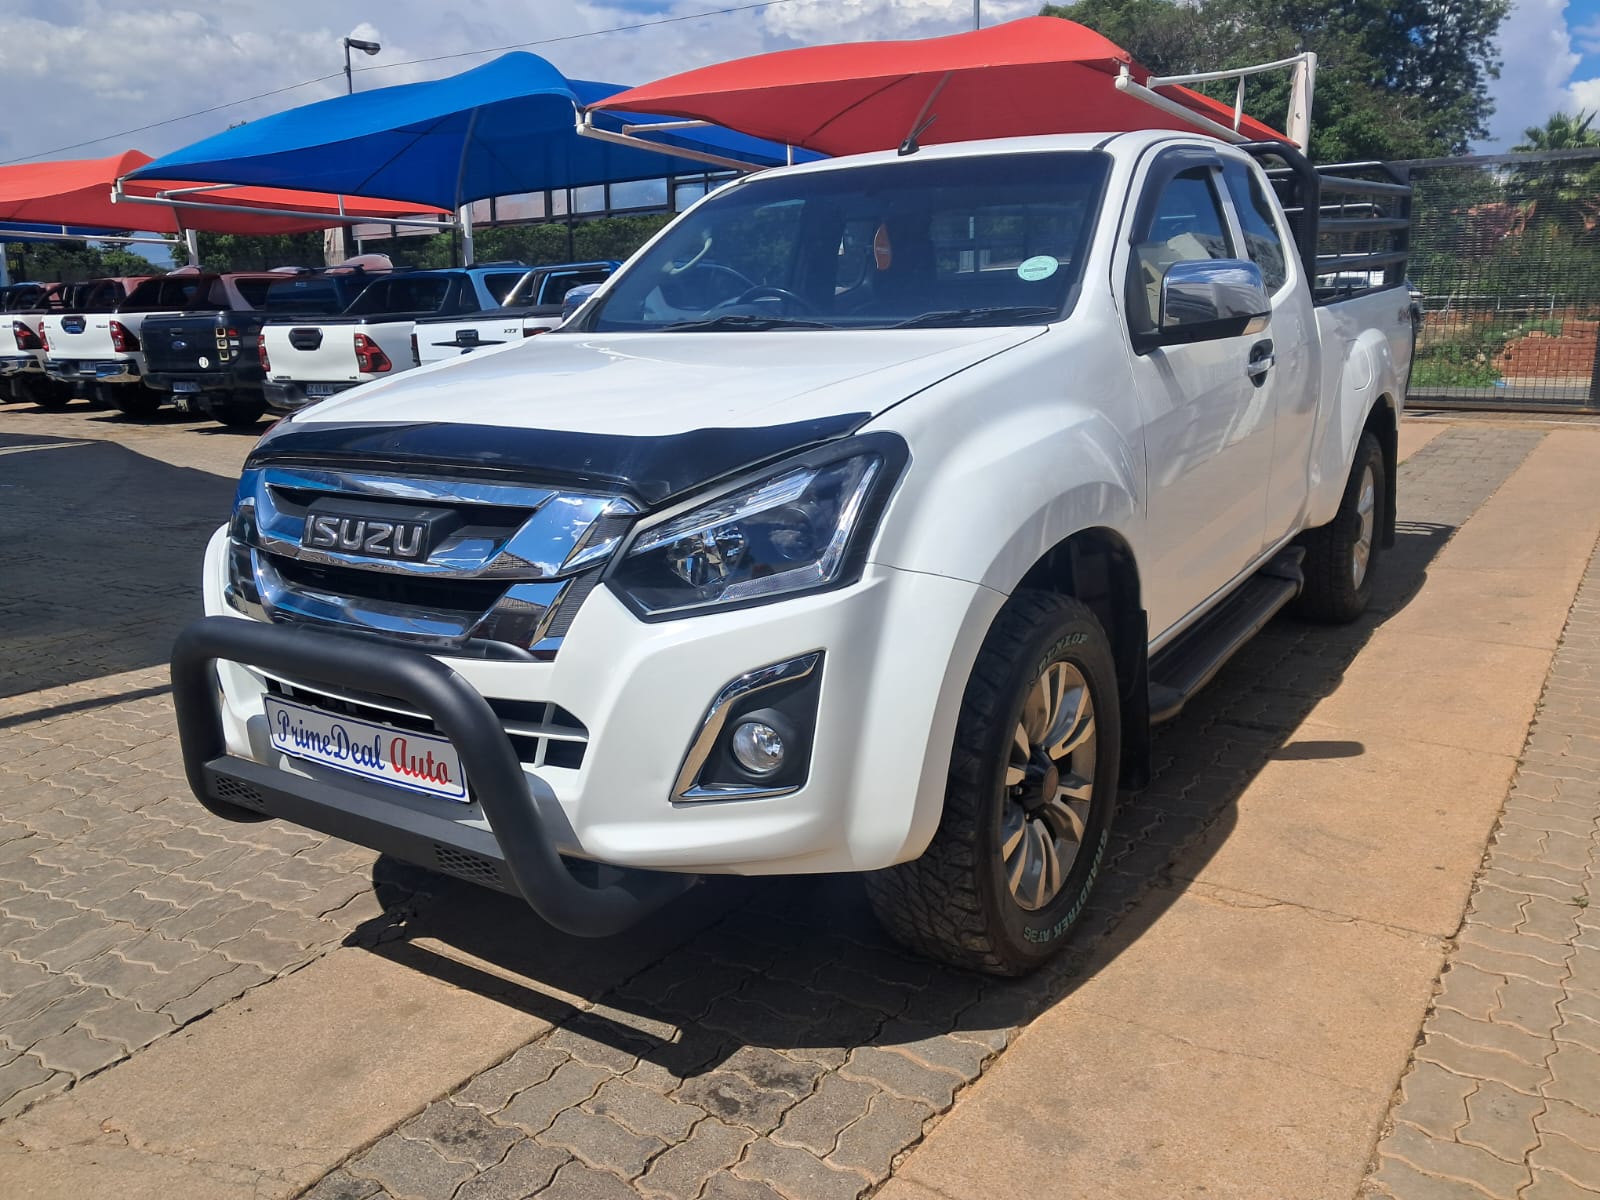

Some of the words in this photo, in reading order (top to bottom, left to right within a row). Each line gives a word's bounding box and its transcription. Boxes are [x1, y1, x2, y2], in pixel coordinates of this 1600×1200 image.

[303, 515, 423, 557] ISUZU
[277, 709, 386, 771] PrimeDeal
[390, 737, 452, 785] Auto
[1052, 828, 1109, 939] GRANDTREK
